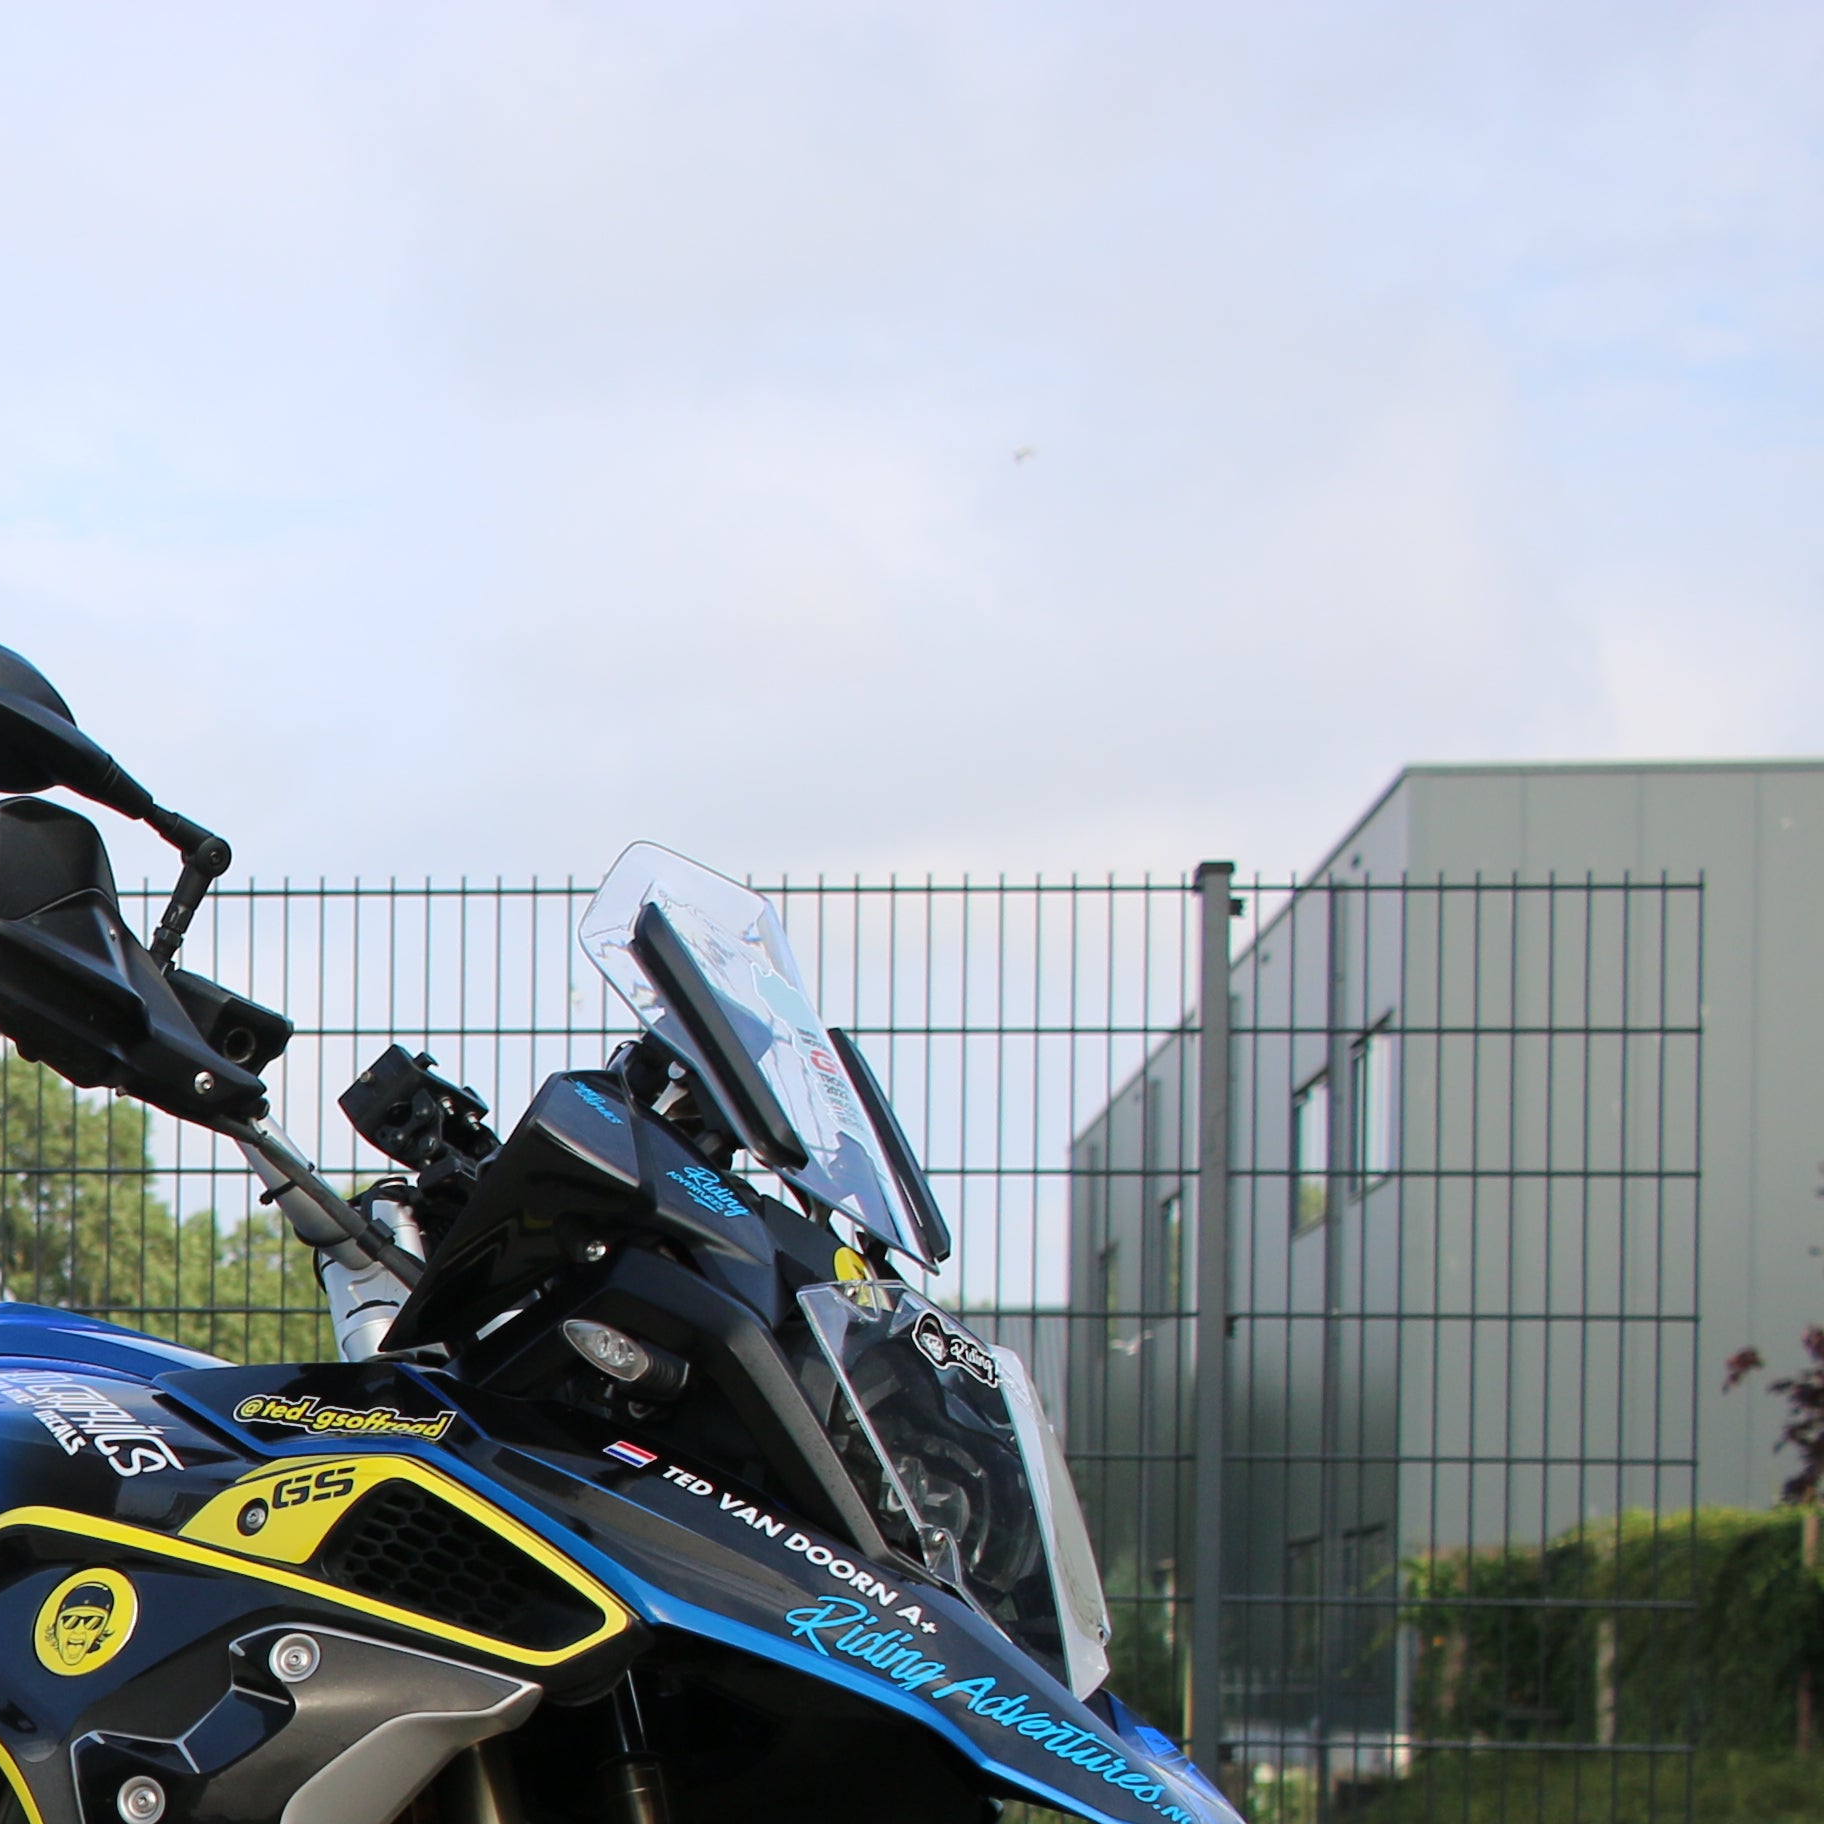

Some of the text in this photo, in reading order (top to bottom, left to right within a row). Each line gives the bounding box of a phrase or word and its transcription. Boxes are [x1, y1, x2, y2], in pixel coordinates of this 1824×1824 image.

[684, 1166, 749, 1217] Riding
[949, 1338, 995, 1381] Riding
[32, 1409, 88, 1457] DECALS
[238, 1397, 452, 1439] @ted_gsoffroad
[270, 1465, 358, 1510] GS
[662, 1464, 940, 1636] TED VAN DOORN A+
[784, 1595, 948, 1692] Riding
